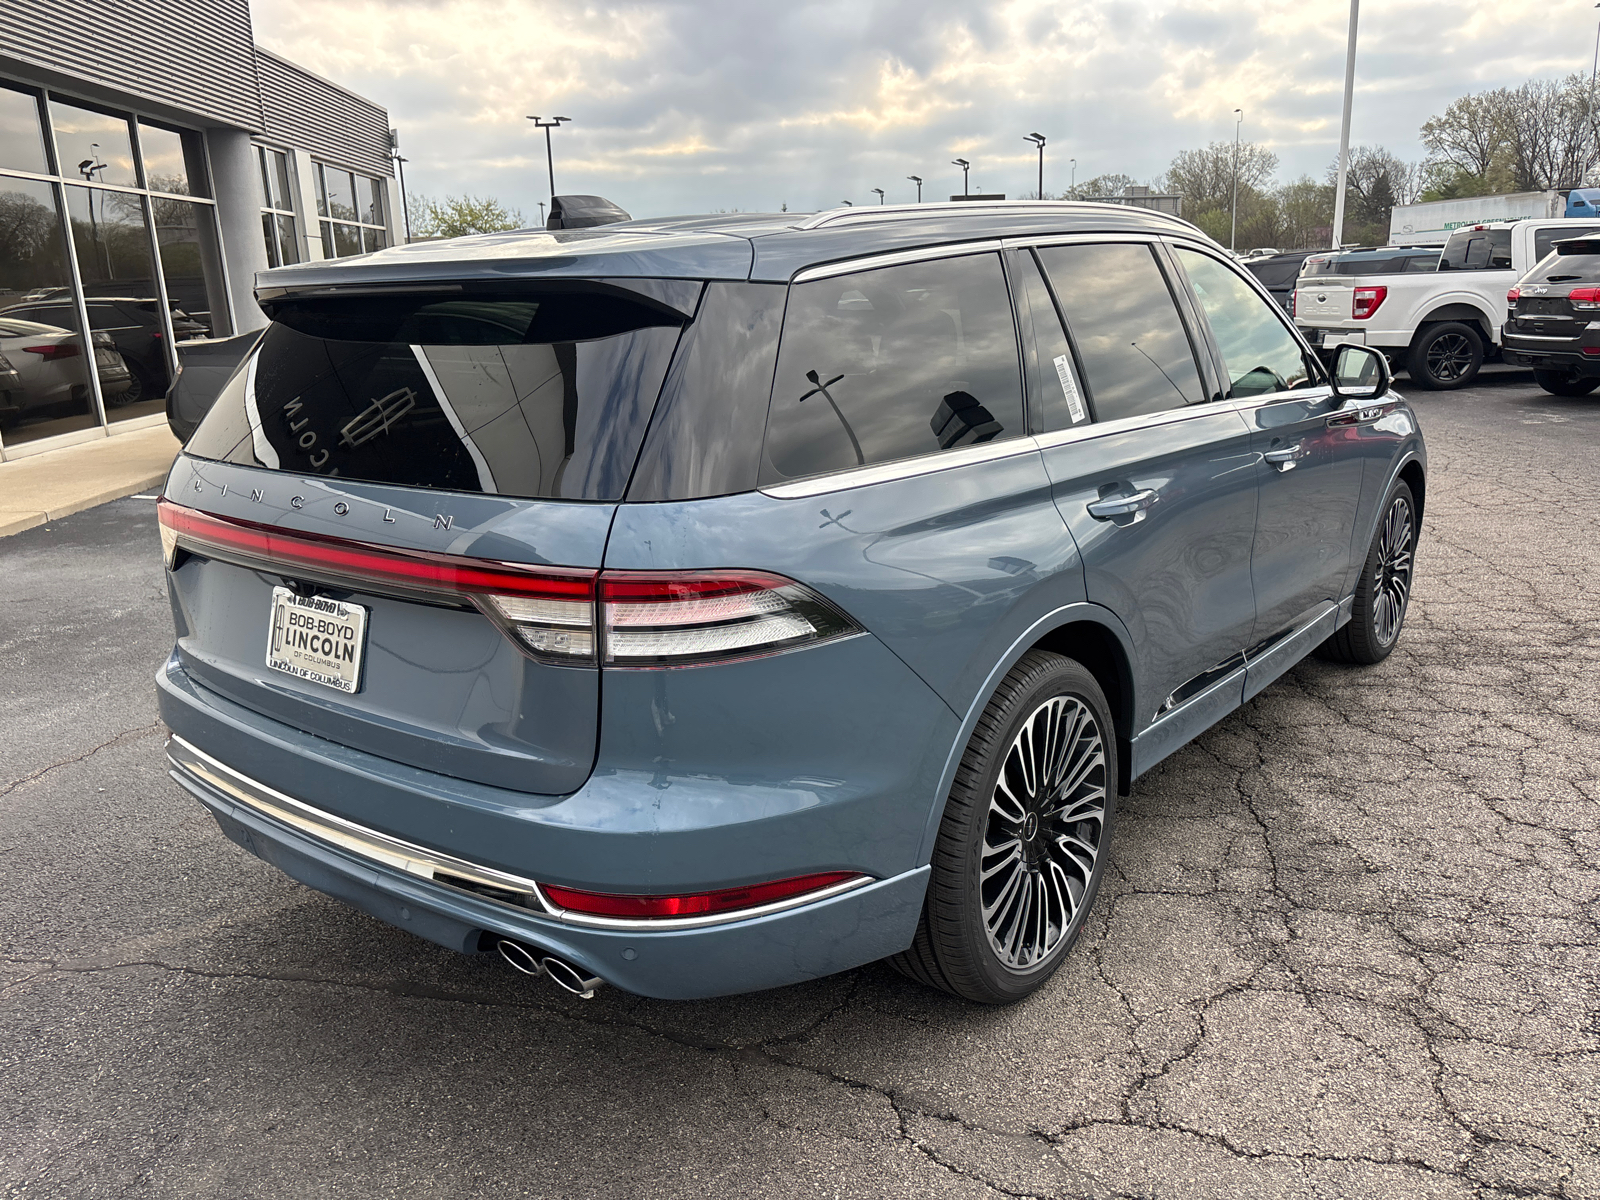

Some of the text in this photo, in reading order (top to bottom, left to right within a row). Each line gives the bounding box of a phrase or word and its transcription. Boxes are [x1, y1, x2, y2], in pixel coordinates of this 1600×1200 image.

[194, 479, 454, 531] LINCOLN
[289, 612, 354, 640] BOB-BOYD
[285, 627, 355, 663] LINCOLN
[293, 650, 341, 670] OF COLUMBUS
[269, 659, 351, 691] LINCOLN OF COLUMBUS
